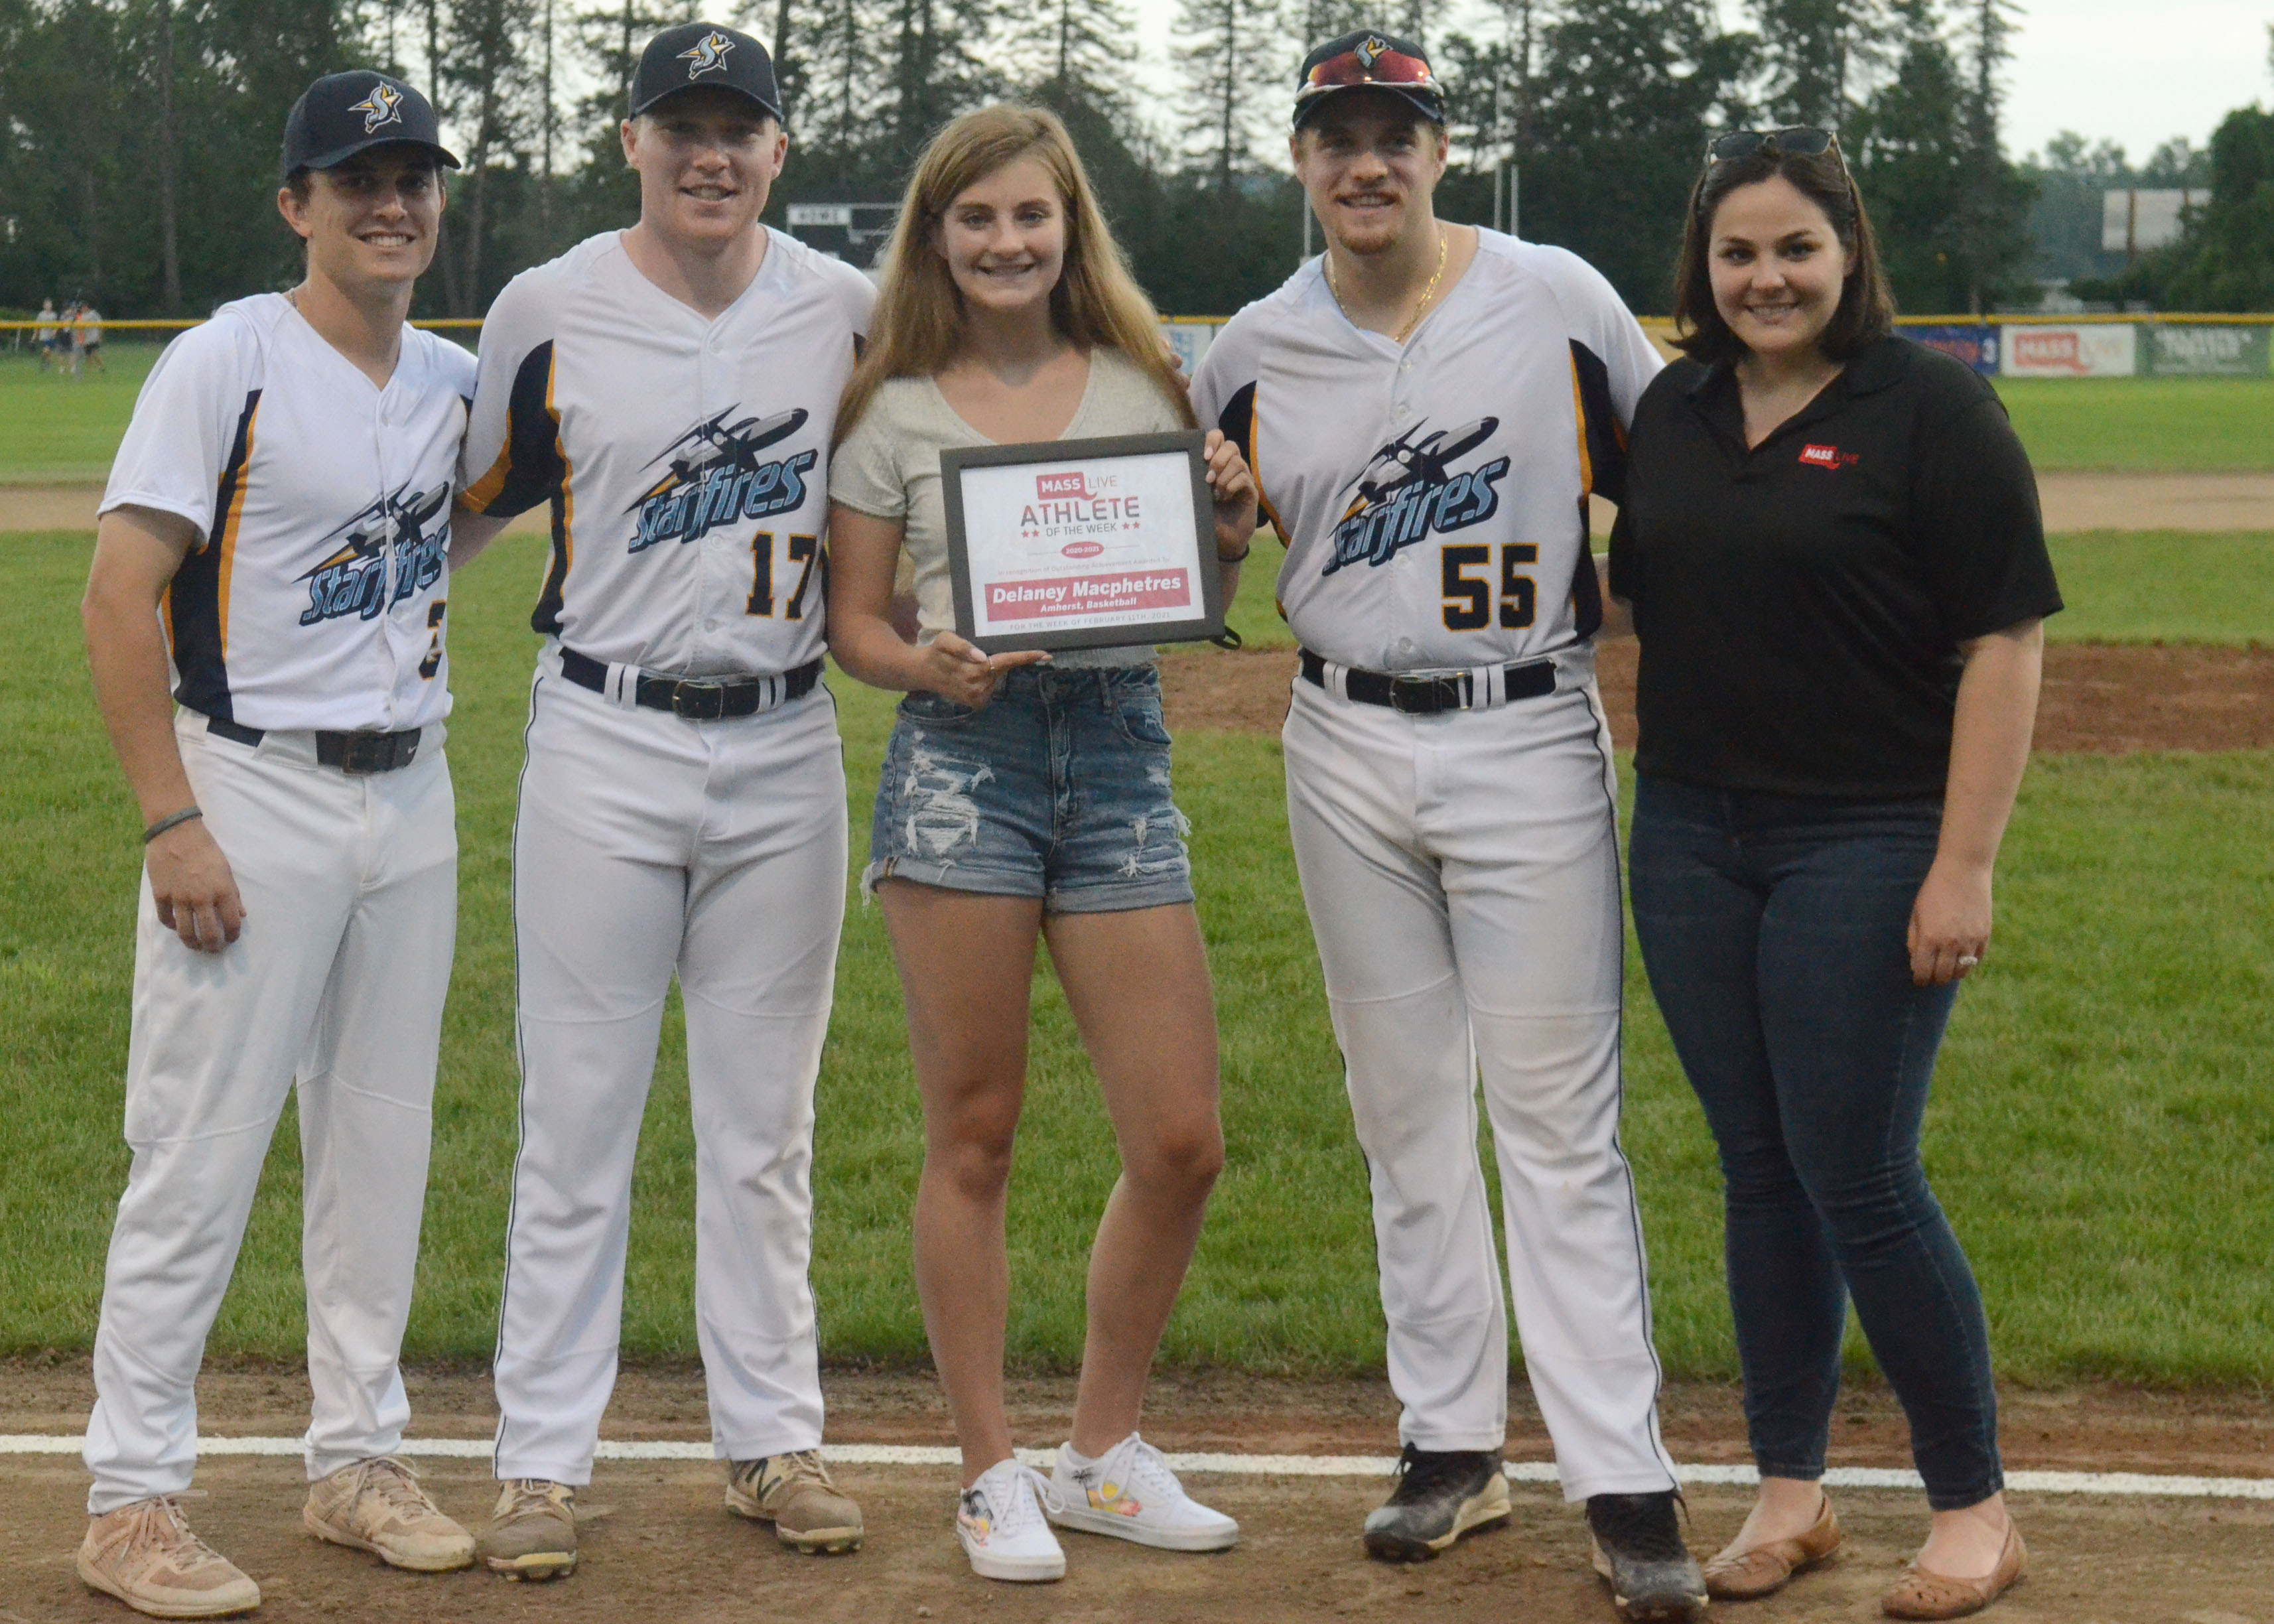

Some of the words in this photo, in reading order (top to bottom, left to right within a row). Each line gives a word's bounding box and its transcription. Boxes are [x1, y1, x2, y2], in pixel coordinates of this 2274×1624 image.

[2021, 340, 2074, 359] MASS
[1805, 448, 1834, 460] MASS
[1041, 478, 1081, 493] MASS
[1089, 475, 1118, 489] LIVE
[628, 448, 818, 554] Starfires
[1020, 496, 1140, 527] ATHLETE
[1046, 527, 1061, 537] OF
[1063, 525, 1083, 535] THE
[1086, 522, 1118, 534] WEEK
[1065, 546, 1100, 555] 2020-2021
[745, 530, 817, 621] 17
[993, 585, 1067, 604] Delaney
[1073, 576, 1181, 598] Macphetres
[1440, 542, 1539, 633] 55
[1040, 602, 1084, 612] Amherst,
[1086, 597, 1137, 609] Basketball
[1084, 616, 1126, 625] FEBRUARY
